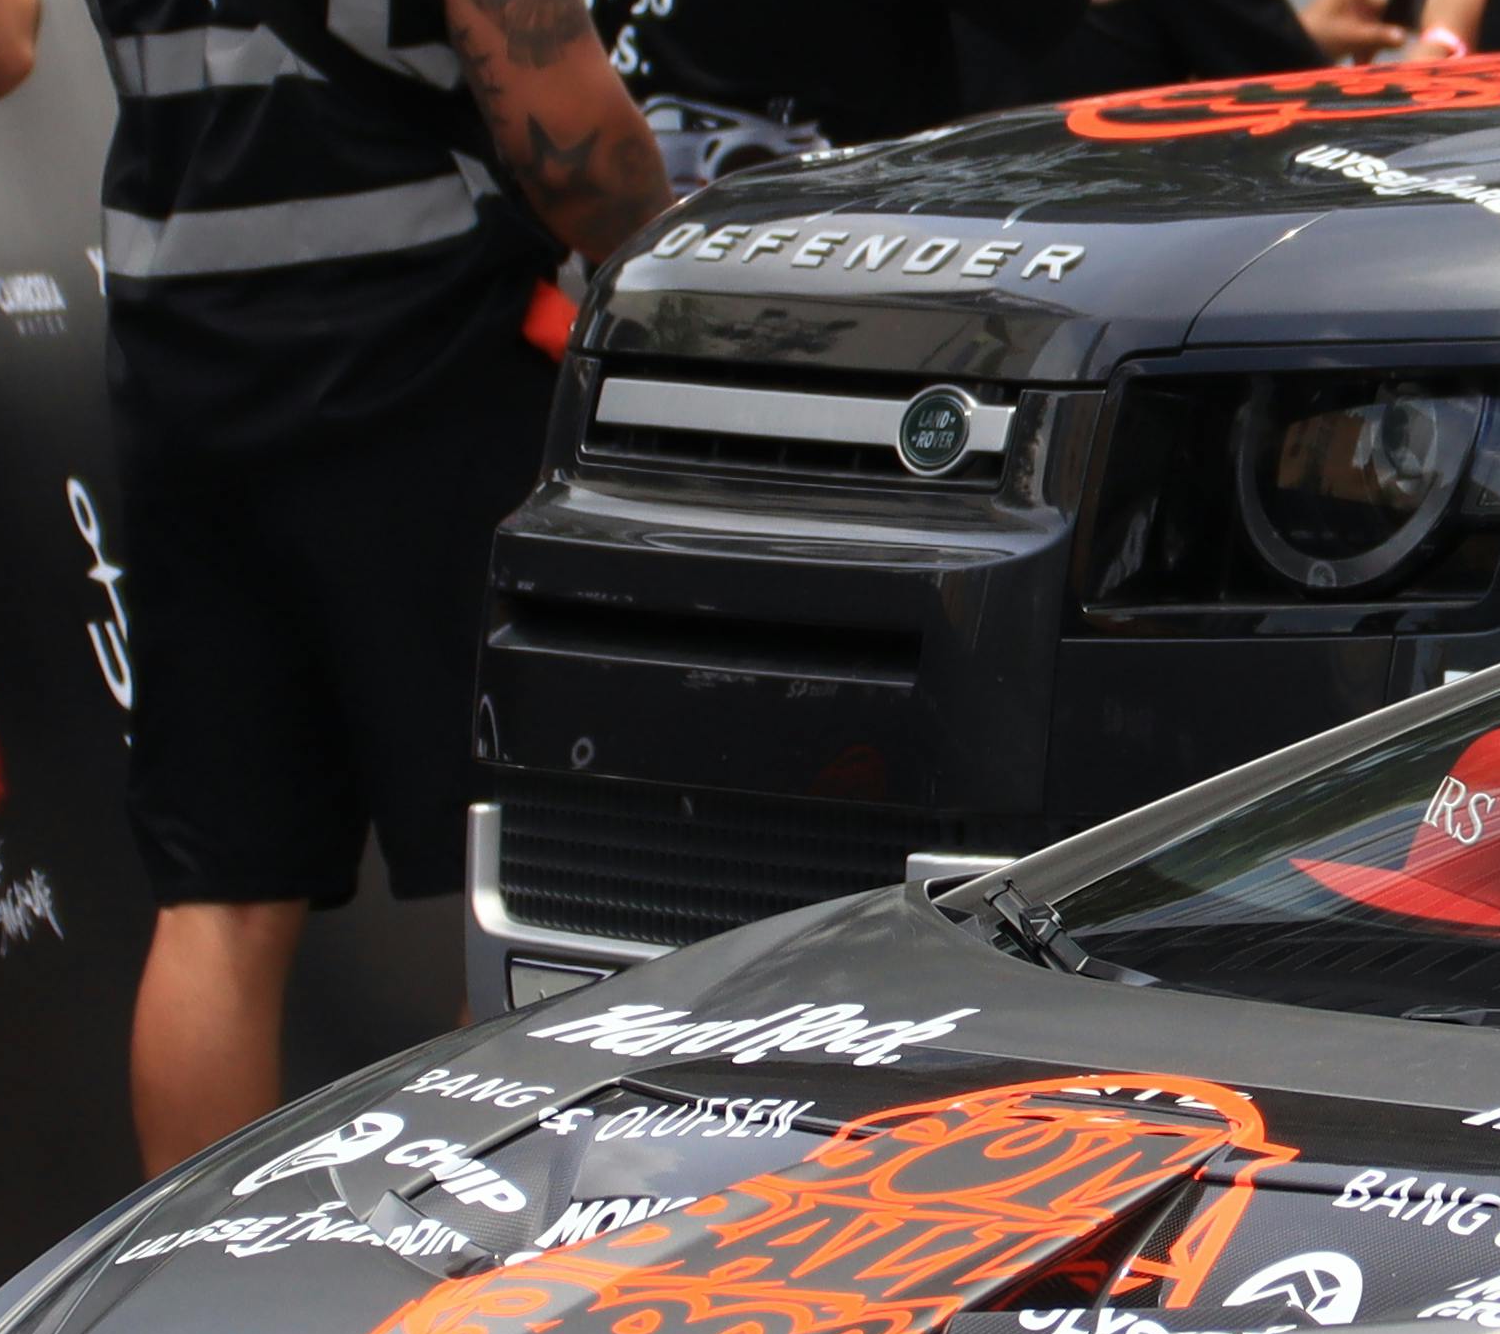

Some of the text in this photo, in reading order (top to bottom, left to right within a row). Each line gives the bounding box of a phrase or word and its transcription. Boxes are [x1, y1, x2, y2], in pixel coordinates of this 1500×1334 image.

[650, 222, 1086, 282] DEFENDER
[526, 1002, 981, 1066] Hard Rock
[401, 1068, 557, 1109] BANG
[593, 1096, 816, 1142] OLUFSEN
[384, 1137, 702, 1249] CHIP MON
[114, 1216, 286, 1265] ULYSSE
